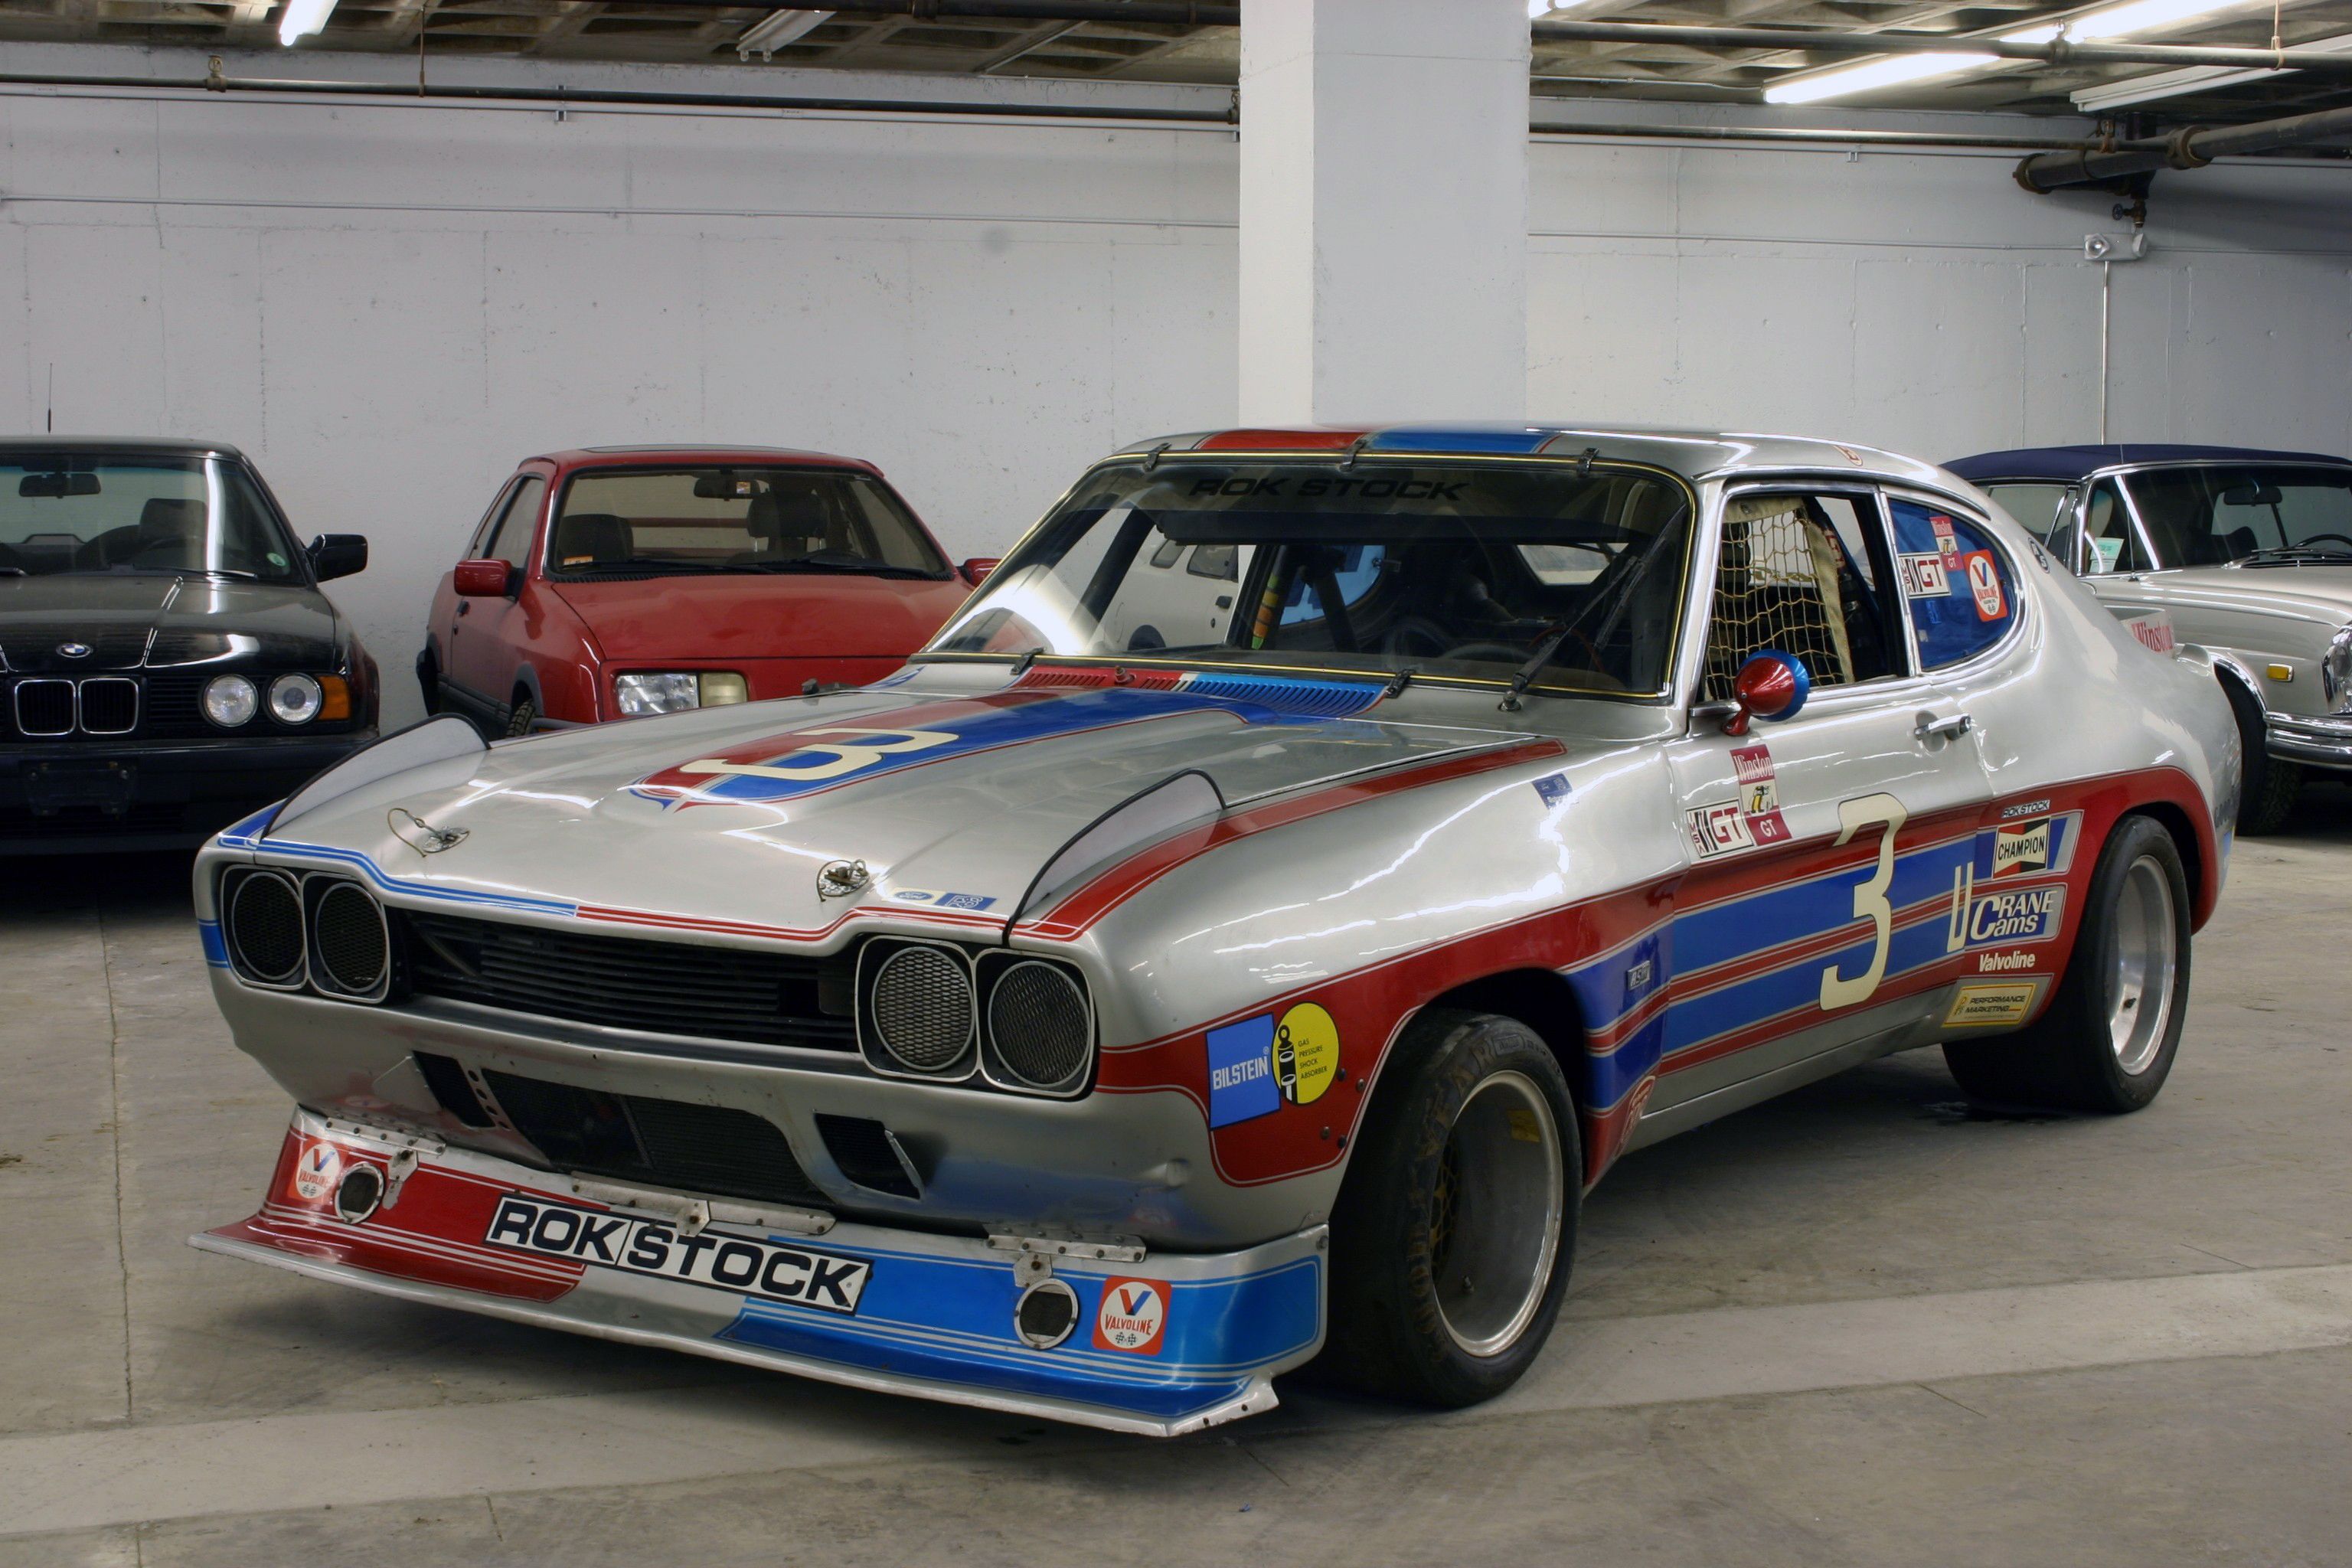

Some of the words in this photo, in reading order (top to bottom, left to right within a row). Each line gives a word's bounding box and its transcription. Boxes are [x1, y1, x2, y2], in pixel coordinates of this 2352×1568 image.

[1188, 478, 1289, 497] ROK
[1297, 479, 1470, 501] STOCK
[1917, 559, 1942, 587] GT
[678, 727, 960, 781] 3
[1733, 753, 1774, 782] Winston
[1710, 806, 1743, 844] GT
[1759, 818, 1777, 838] GT
[1998, 835, 2046, 861] CHAMPION
[1818, 792, 1908, 1011] 3
[1978, 950, 2036, 972] Valvoline
[1969, 995, 2026, 1004] PERFORMANCE
[1298, 1038, 1310, 1047] GAS
[1298, 1044, 1324, 1058] PRESSURE
[1212, 1056, 1269, 1091] BILSTEIN
[1299, 1057, 1318, 1069] SHOCK
[1300, 1065, 1328, 1080] ABSORBER
[490, 1200, 628, 1263] ROK
[626, 1226, 865, 1308] STOCK
[1105, 1314, 1154, 1336] VALVOLINE
